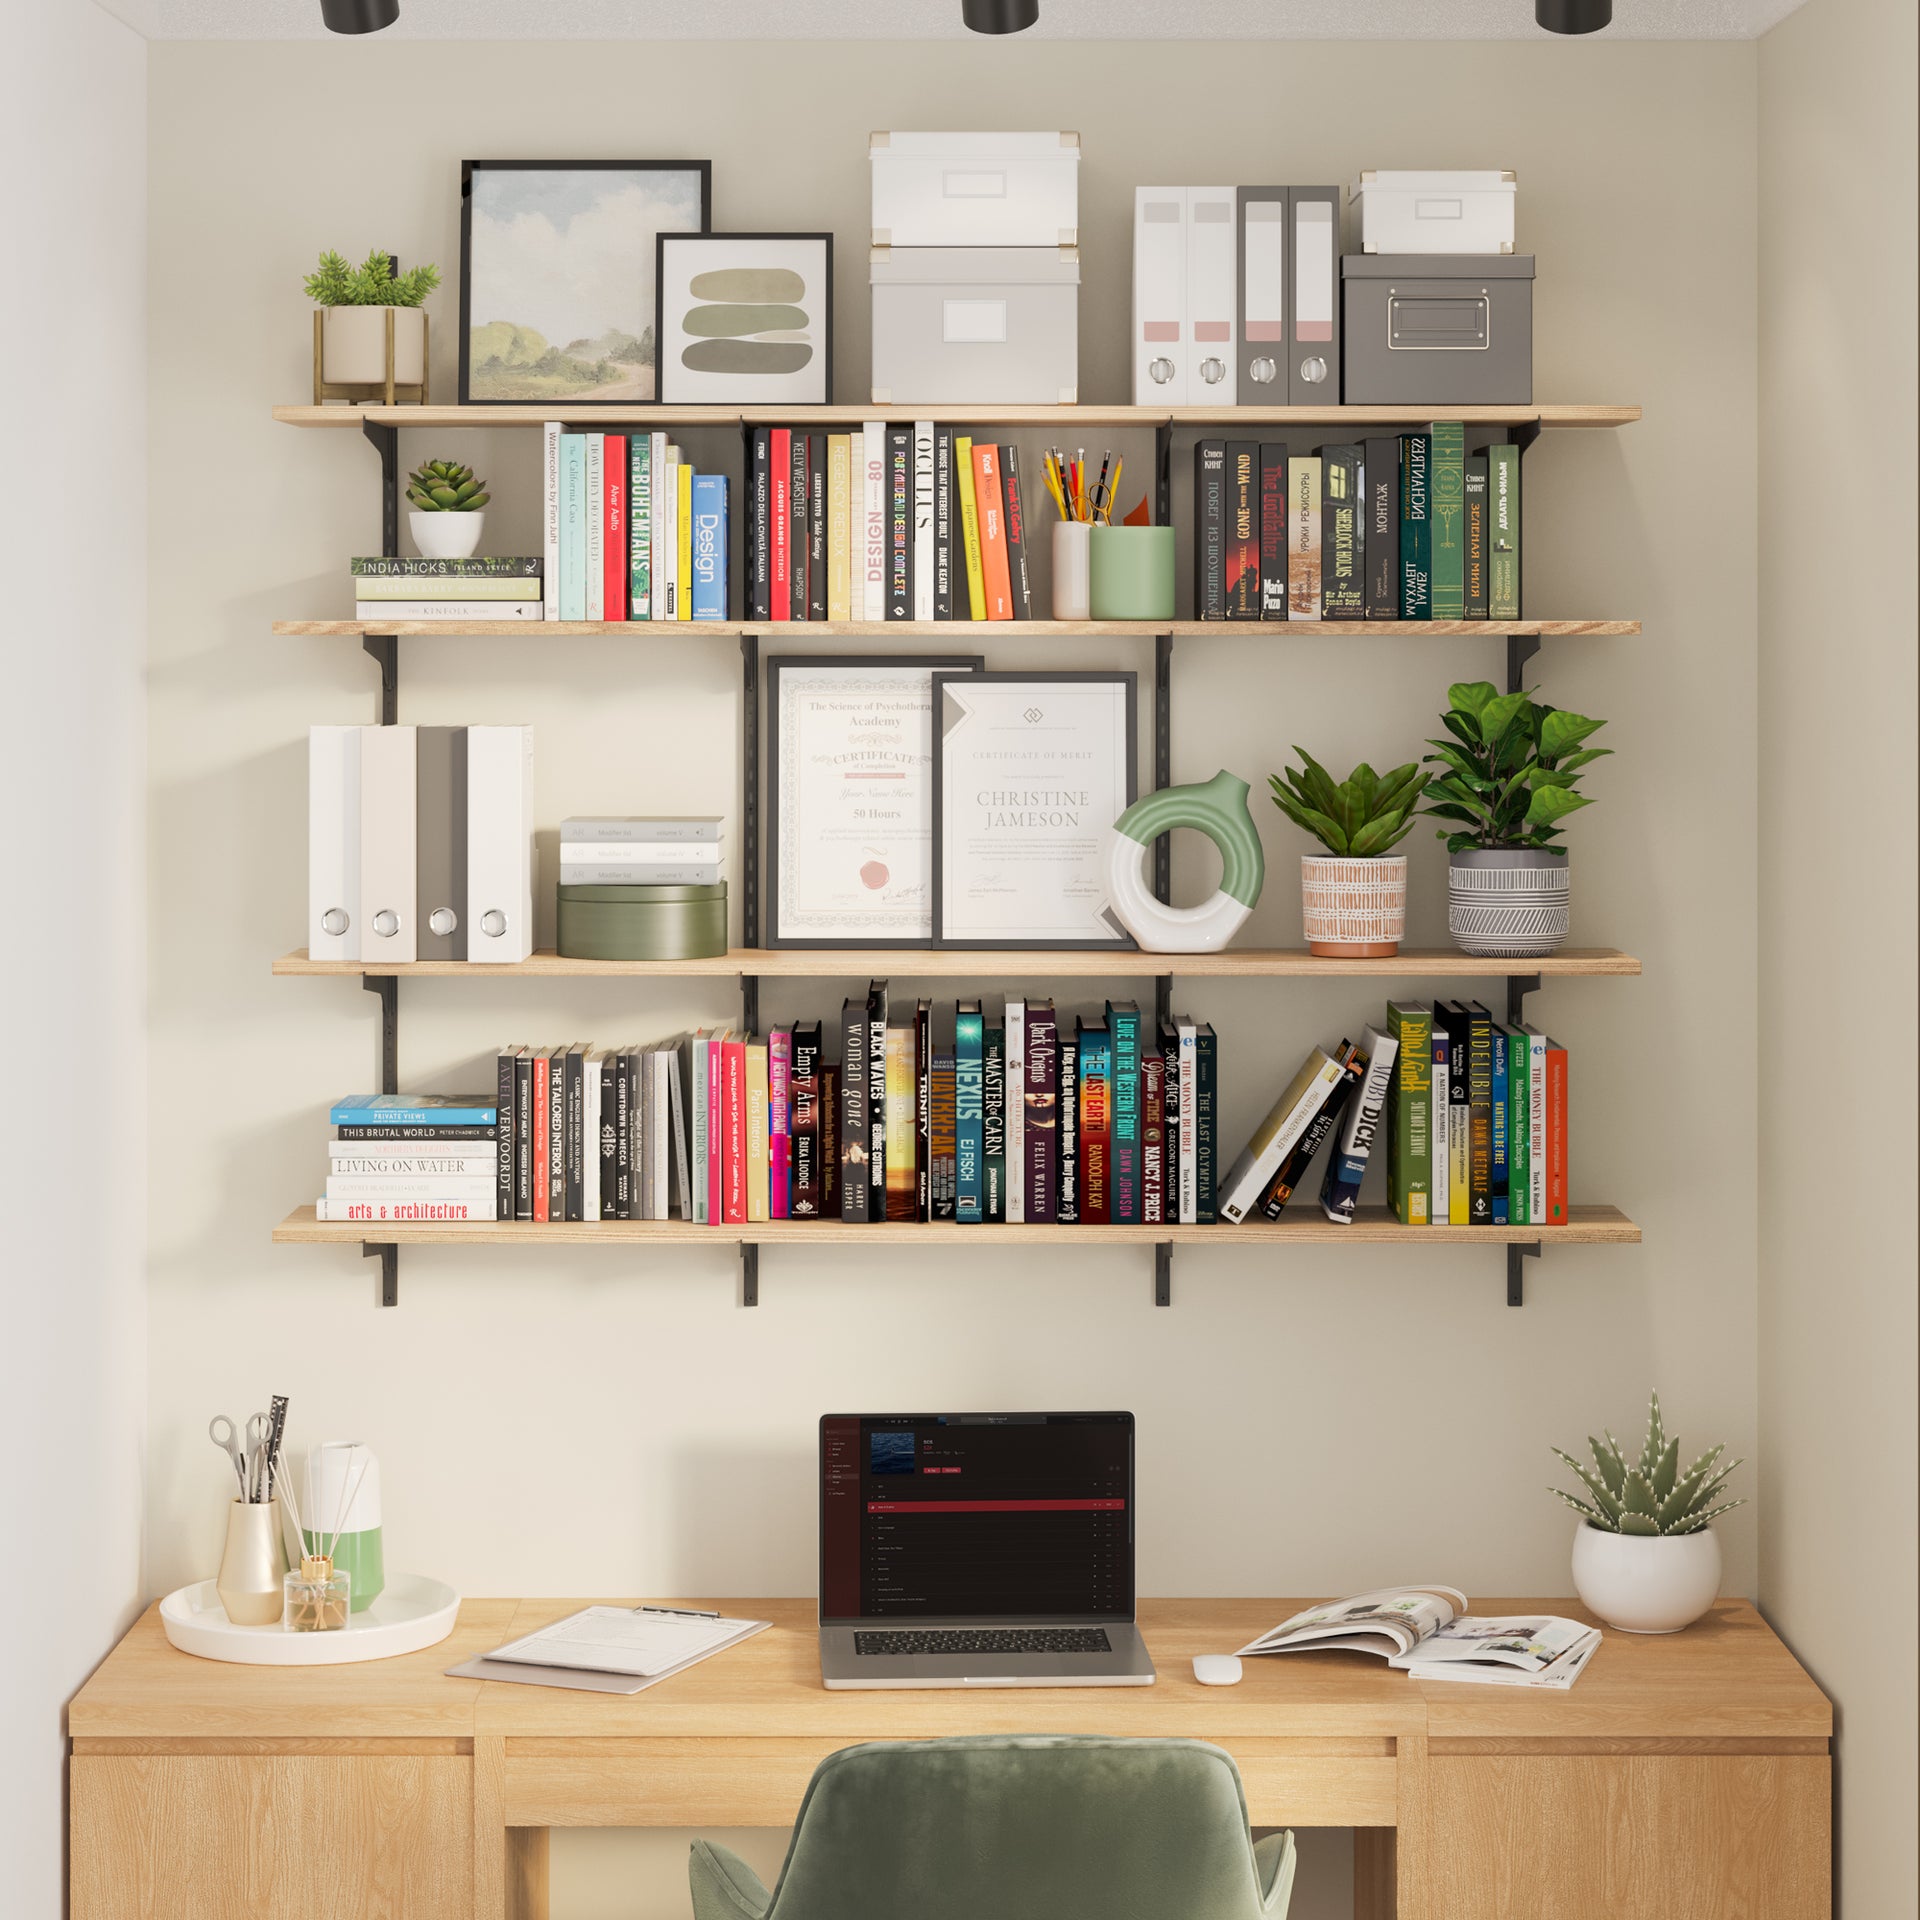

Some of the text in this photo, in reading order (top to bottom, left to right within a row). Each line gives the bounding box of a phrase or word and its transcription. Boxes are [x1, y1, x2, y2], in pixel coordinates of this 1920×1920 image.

[548, 432, 557, 544] Watercolors by Finn Juhl
[632, 456, 640, 472] NEW
[641, 459, 650, 472] THE
[793, 442, 804, 518] KELLY WEARSTLER
[916, 438, 933, 528] OCULUS
[939, 436, 948, 538] THE HOUSE THAT PINTEREST BUILT
[1237, 454, 1250, 485] WIND
[1499, 462, 1508, 530] ДЕЛАТЬ ФИЛЬМ
[611, 484, 620, 530] Alvar Aalto
[632, 474, 650, 571] BOHEMIANS
[834, 446, 844, 556] REGENCY REDUX
[868, 460, 882, 582] DESIGN 80
[1237, 508, 1250, 539] GONE
[1264, 465, 1284, 560] The Godfather
[1301, 472, 1310, 552] УРОКИ РЕЖИССУРЫ
[1377, 484, 1388, 533] МОНТАЖ
[363, 562, 446, 574] INDIA HICKS
[696, 514, 718, 582] Design
[758, 526, 766, 551] CIVILTÀ
[938, 547, 948, 594] DIANE KEATON
[966, 504, 980, 572] Japanese Gardens
[1207, 482, 1218, 612] ПОБЕГ ИЗ ШОУШЕНКА
[1336, 508, 1352, 577] SHERLOCK HOLMS
[1470, 503, 1480, 598] ЗЕЛЕНАЯ МИЛЯ
[796, 568, 804, 600] RHAPSODY
[1264, 579, 1284, 594] Mario
[1264, 594, 1280, 610] Puzo
[810, 702, 827, 711] The
[830, 702, 862, 711] Science
[864, 702, 874, 711] of
[850, 716, 902, 728] Academy
[834, 751, 915, 765] CERTIFICATE
[854, 809, 902, 819] 50 Hours
[976, 792, 1090, 806] CHRISTINE
[984, 812, 1079, 830] JAMESON
[842, 1024, 862, 1127] woman gone
[870, 1022, 885, 1100] BLACK WAVES
[1026, 1022, 1056, 1082] Dark Origins
[1117, 1018, 1136, 1140] LOVE ON THE WESTERN FRONT
[1366, 1062, 1392, 1106] MOBY
[1400, 1020, 1430, 1093] Harry Potter
[1471, 1020, 1490, 1108] INDELIBLE
[1495, 1038, 1505, 1076] Neroli Duffy
[618, 1078, 626, 1127] COUNTDOWN
[792, 1046, 817, 1124] Empty Arms
[920, 1074, 928, 1138] TRINITY
[956, 1058, 982, 1120] NEXUS
[985, 1046, 1002, 1155] THE MASTER OF CARN
[1086, 1046, 1104, 1131] THE LAST EARTH
[1182, 1060, 1191, 1155] THE MONEY BUBBLE
[1439, 1103, 1446, 1111] OF
[1532, 1067, 1542, 1159] THE MONEY BUBBLE
[344, 1128, 436, 1137] THIS BRUTAL WORLD
[500, 1064, 510, 1192] AXEL VERVOORDT
[552, 1068, 562, 1174] THE TAILORED INTERIOR
[696, 1072, 706, 1164] mexican INTERIORS
[751, 1090, 763, 1158] Paris Interiors
[1199, 1092, 1212, 1200] THE LAST OLYMPIAN
[1352, 1106, 1382, 1151] DICK
[1495, 1102, 1505, 1164] WANTING TO BE FREE
[337, 1160, 465, 1172] LIVING ON WATER
[618, 1138, 626, 1166] MECCA
[960, 1139, 974, 1180] EJ FISCH
[1034, 1142, 1046, 1213] FELIX WARREN
[1088, 1144, 1102, 1208] RANDOLPH KAY
[1120, 1149, 1132, 1216] DAWN JOHNSON
[1145, 1146, 1160, 1222] NANCY J. PRICE
[1168, 1129, 1176, 1202] GREGORY MAGUIRE
[1474, 1120, 1488, 1192] DAWN METCALF
[348, 1203, 468, 1219] arts & architecture
[845, 1182, 853, 1210] JESPER
[856, 1184, 864, 1208] HARRY
